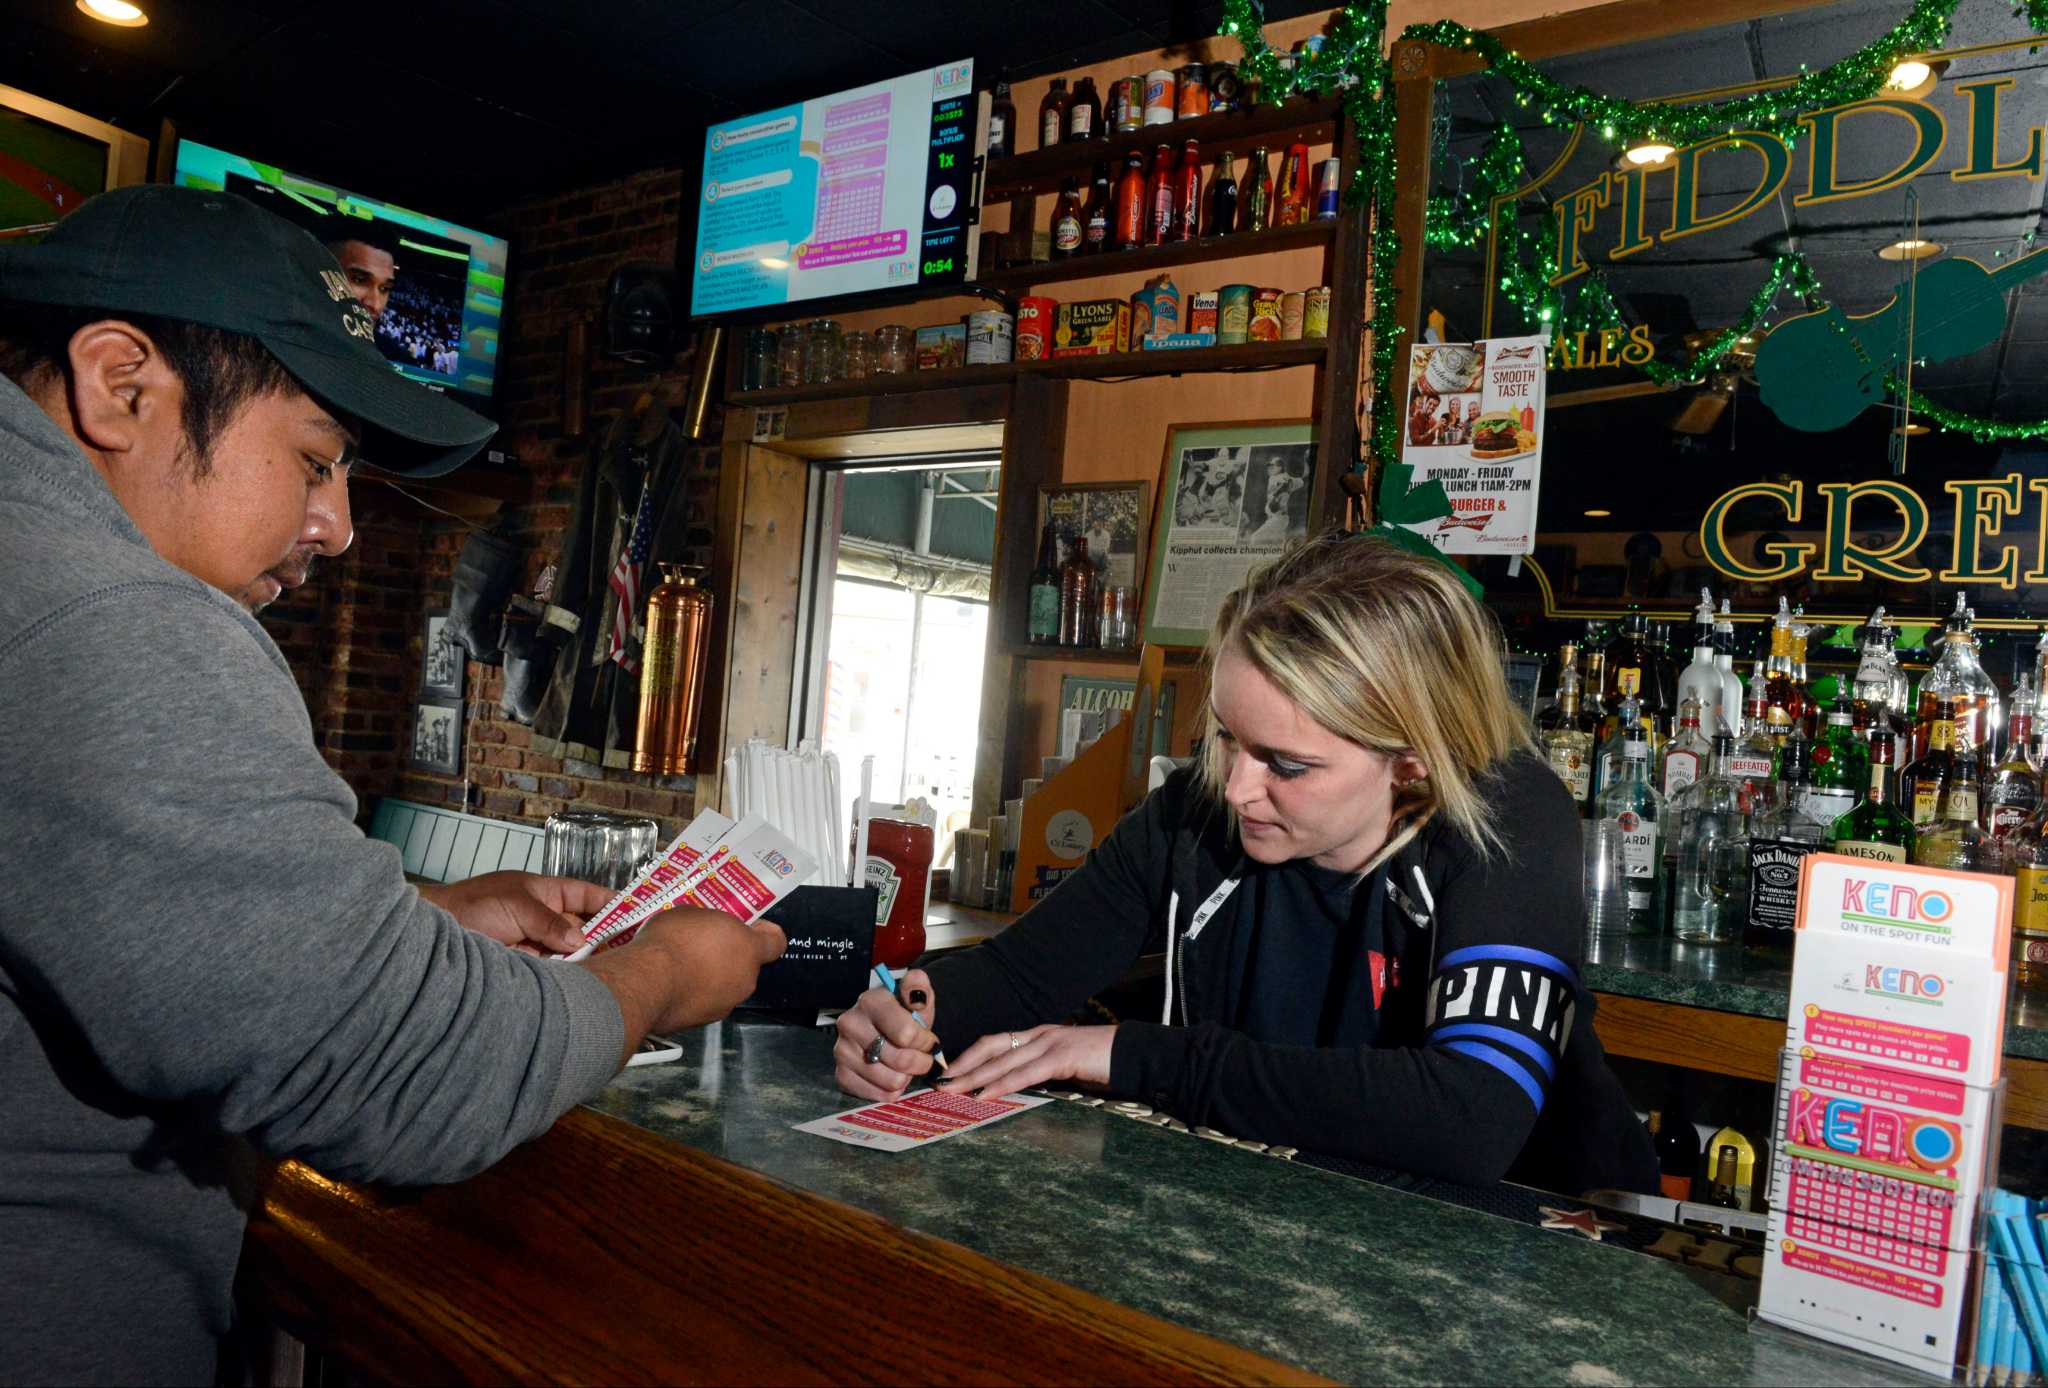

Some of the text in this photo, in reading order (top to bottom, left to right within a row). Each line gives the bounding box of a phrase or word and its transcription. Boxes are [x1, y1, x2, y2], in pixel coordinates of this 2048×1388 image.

[934, 64, 970, 87] KENO
[939, 126, 959, 137] BONUS
[1549, 76, 2048, 287] FIDDL
[926, 238, 938, 247] TIME
[923, 258, 953, 275] 0:54
[1073, 304, 1112, 318] LYONS
[1548, 325, 1655, 371] ALES
[1492, 370, 1536, 384] SMOOTH
[1498, 384, 1529, 398] TASTE
[1427, 467, 1469, 480] MONDAY
[1477, 466, 1514, 479] FRIDAY
[1445, 479, 1477, 492] LUNCH
[1480, 479, 1531, 491] 11AM-2PM
[1424, 533, 1450, 547] AFT
[1204, 545, 1237, 555] collects
[1239, 544, 1284, 556] champion
[1731, 760, 1770, 772] BEEFEATER
[1624, 833, 1652, 846] ARDÍ
[1752, 851, 1774, 867] JACK
[1840, 847, 1896, 863] JAMESON
[761, 849, 795, 877] KENO
[1842, 878, 1953, 923] KENO
[2031, 888, 2048, 903] Jos
[1840, 921, 1952, 946] ON THE SPOT FUN
[788, 936, 854, 953] and mingle
[1864, 963, 1945, 998] KENO
[1788, 1094, 1963, 1170] KENO
